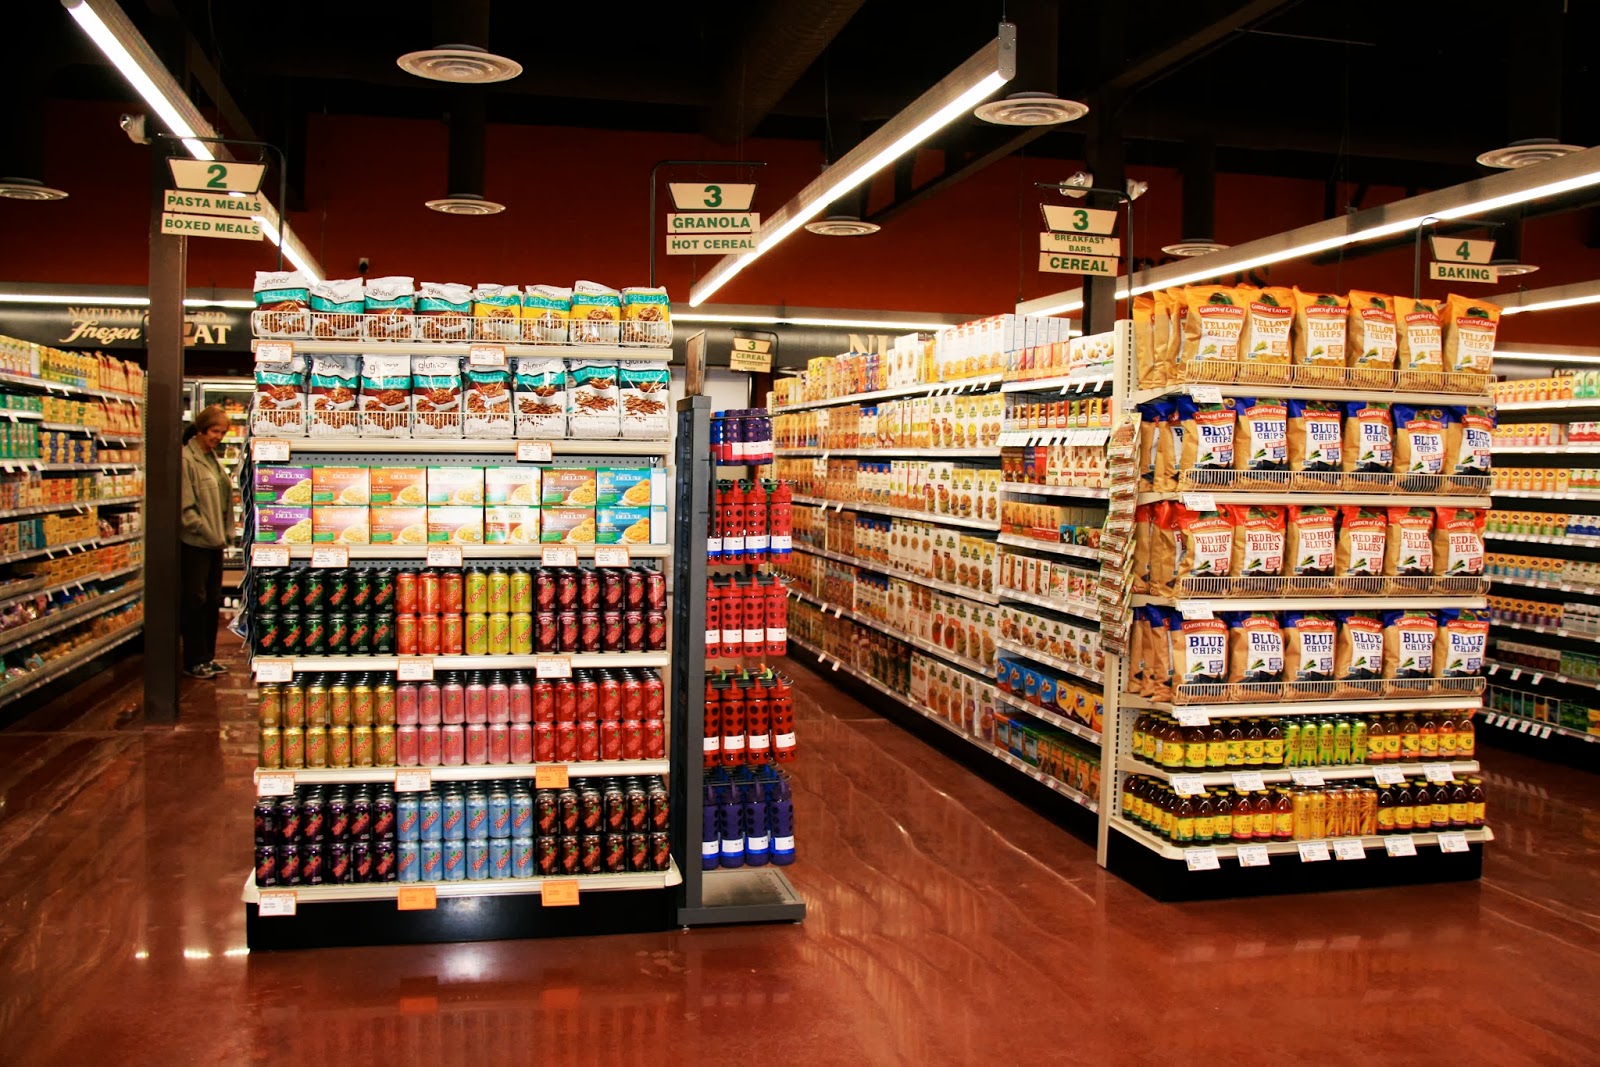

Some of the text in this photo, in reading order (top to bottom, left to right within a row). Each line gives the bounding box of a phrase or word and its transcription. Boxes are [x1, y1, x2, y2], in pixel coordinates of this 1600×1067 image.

[207, 164, 227, 188] 2
[703, 185, 722, 207] 3
[167, 195, 262, 212] PASTA MEALS
[672, 217, 751, 228] GRANOLA
[1072, 210, 1089, 230] 3
[165, 218, 260, 235] BOXED MEALS
[1054, 234, 1105, 244] BREAKFAST
[672, 239, 756, 250] HOT CEREAL
[1069, 245, 1092, 253] BARS
[1456, 241, 1470, 260] 4
[1050, 257, 1108, 272] CEREAL
[1438, 267, 1489, 280] BAKING
[529, 297, 566, 309] PRETZELS
[68, 307, 149, 321] NATURAL
[1203, 320, 1241, 330] YELLOW
[1253, 317, 1291, 328] YELLOW
[1309, 322, 1345, 331] YELLOW
[59, 319, 231, 345] Frozen AT
[1207, 330, 1237, 338] CHIPS
[1257, 327, 1286, 335] CHIPS
[1365, 324, 1394, 334] YELLOW
[1409, 329, 1441, 337] YELLOW
[1370, 332, 1393, 341] CHIPS
[1459, 332, 1494, 343] YELLOW
[748, 341, 756, 350] 3
[1463, 340, 1490, 350] CHIPS
[736, 353, 766, 361] CEREAL
[626, 371, 662, 380] PRETZELS
[370, 377, 407, 387] PTZELS
[1201, 425, 1233, 437] BLUE
[1253, 421, 1286, 433] BLUE
[1310, 423, 1339, 434] BLUE
[1205, 436, 1232, 444] CHIPS
[1257, 432, 1284, 440] CHIPS
[1312, 433, 1338, 441] CHIPS
[1416, 445, 1437, 453] CHIPS
[1189, 521, 1211, 530] GARDEN
[1195, 534, 1231, 544] RED HOT
[1247, 533, 1265, 542] RED
[1317, 530, 1334, 540] HOT
[1352, 534, 1385, 543] RED HOT
[1403, 531, 1421, 540] RED
[1450, 536, 1468, 544] RED
[1201, 543, 1227, 553] BLUES
[1252, 542, 1280, 551] BLUES
[1305, 540, 1332, 549] BLUES
[1357, 543, 1381, 551] BLUES
[1184, 621, 1204, 630] GARDEN
[1189, 636, 1224, 648] BLUE
[1251, 633, 1281, 644] BLUE
[1303, 634, 1333, 645] BLUE
[1352, 631, 1382, 644] BLUE
[1403, 632, 1433, 643] BLUE
[1451, 634, 1484, 646] BLUE
[1192, 647, 1222, 655] CHIPS
[1254, 644, 1280, 652] CHIPS
[1306, 645, 1332, 653] CHIPS
[1454, 645, 1480, 653] CHIPS
